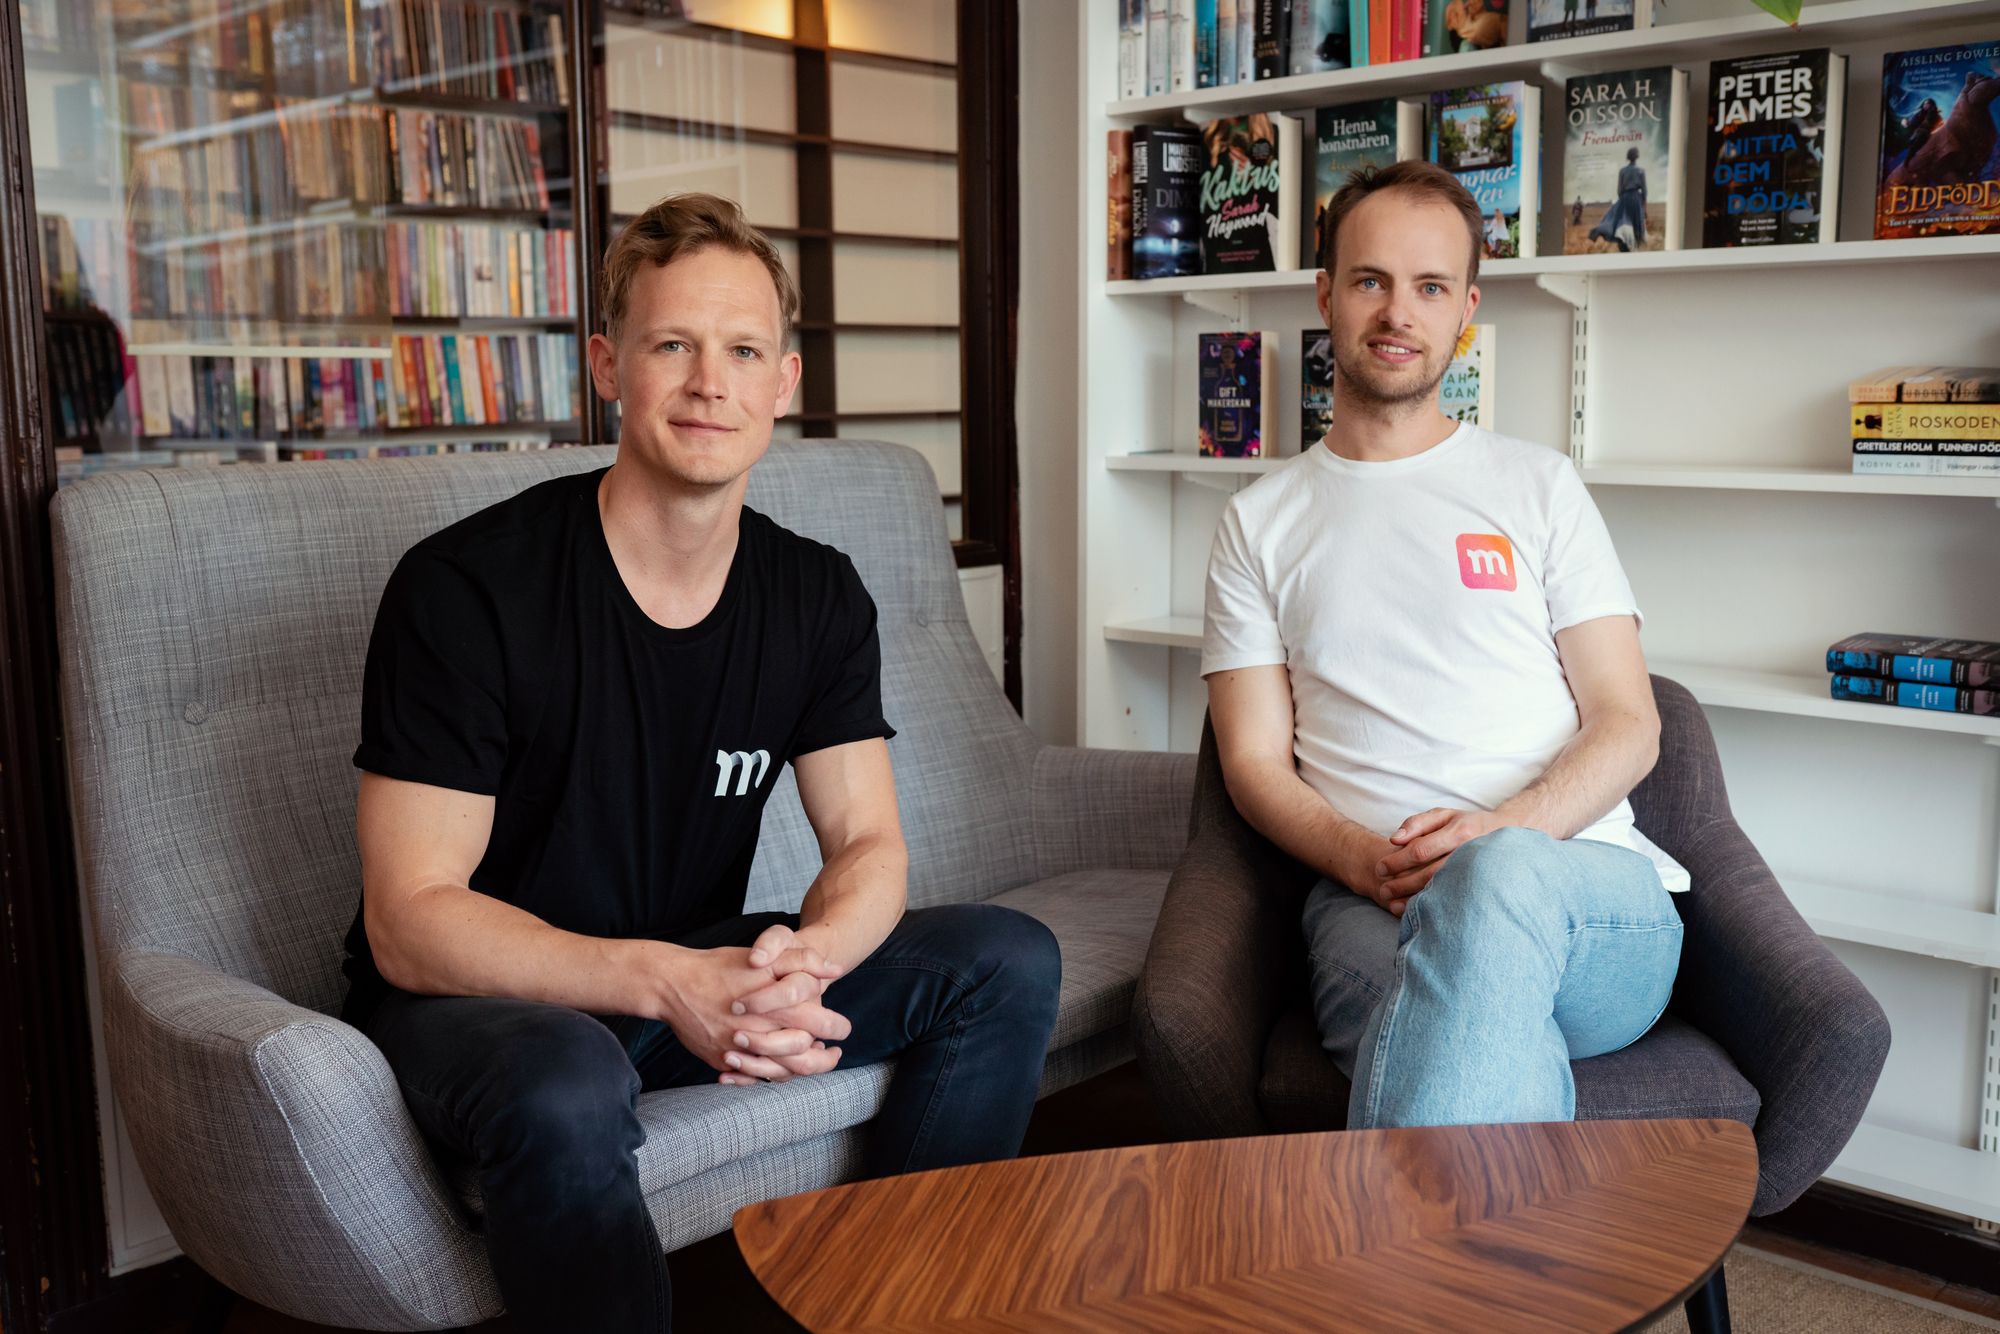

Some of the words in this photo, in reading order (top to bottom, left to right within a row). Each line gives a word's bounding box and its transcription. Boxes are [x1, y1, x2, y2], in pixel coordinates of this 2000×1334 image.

[1901, 52, 1952, 67] AISLING
[1571, 82, 1628, 106] SARA
[1635, 79, 1656, 98] H.
[1719, 67, 1813, 101] PETER
[1569, 101, 1662, 128] OLSSON
[1714, 92, 1813, 132] JAMES
[1333, 118, 1377, 136] Henna
[1582, 128, 1643, 146] Fiendevän
[1319, 134, 1390, 155] konstnären
[1723, 133, 1798, 157] HITTA
[1199, 159, 1280, 214] Kaktus
[1714, 160, 1771, 186] DEM
[1221, 194, 1259, 221] Sarah
[1727, 185, 1810, 215] DÖDA
[1206, 203, 1270, 239] Haywood
[1218, 386, 1238, 398] GIFT
[1856, 442, 1902, 452] GRETELISE
[1903, 443, 1933, 452] HOLM
[1938, 444, 1978, 453] FUNNEN
[1466, 548, 1508, 576] m
[714, 749, 771, 797] m
